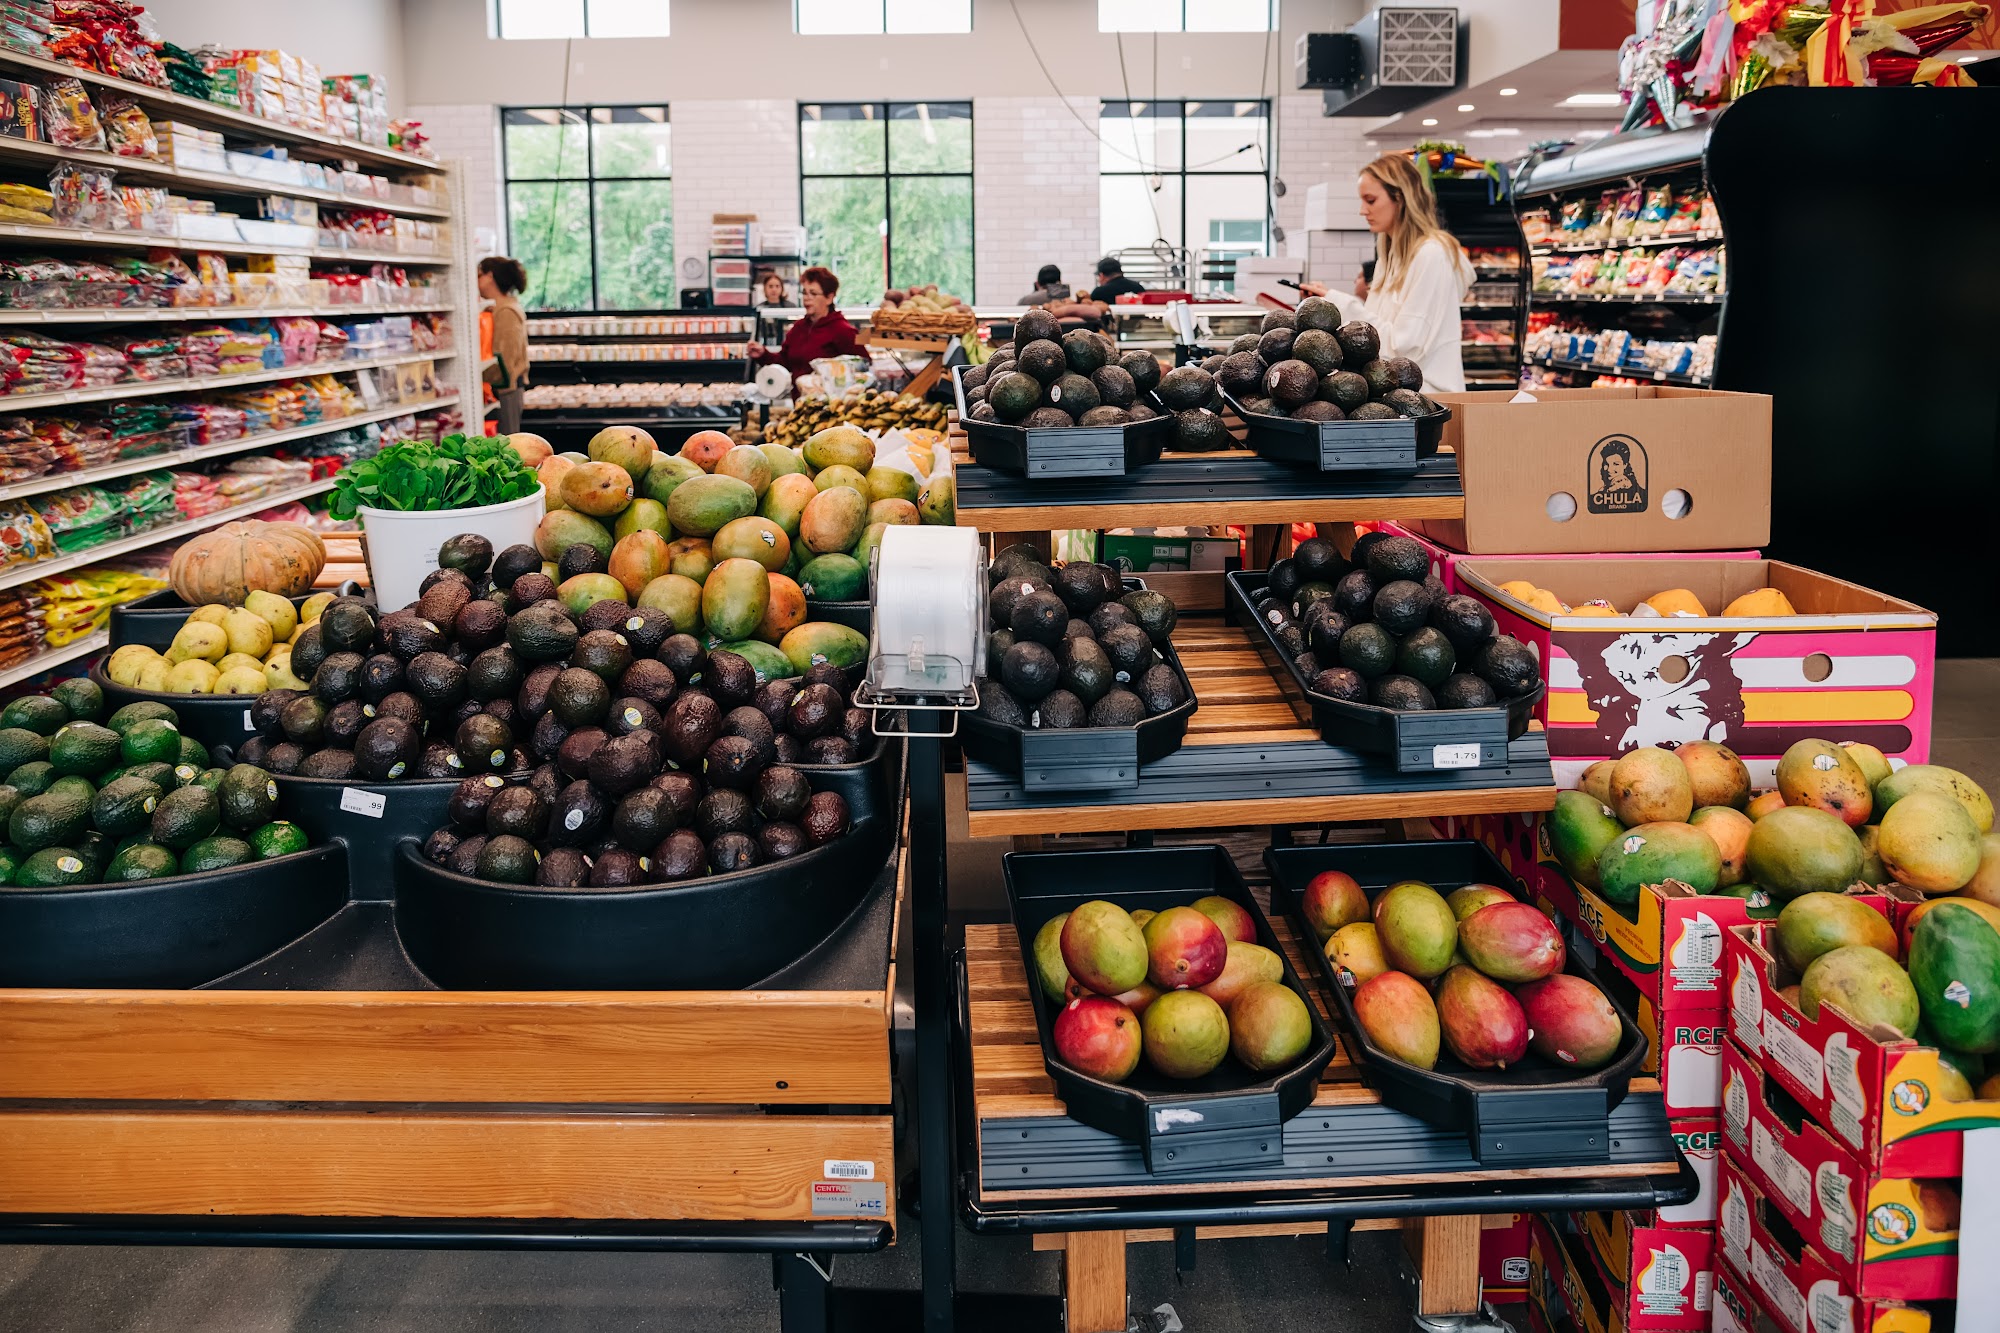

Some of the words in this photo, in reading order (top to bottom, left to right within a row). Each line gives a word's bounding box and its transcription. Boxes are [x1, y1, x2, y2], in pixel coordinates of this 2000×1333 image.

[1593, 492, 1642, 504] CHULA
[1578, 892, 1604, 928] RCF
[1675, 1027, 1727, 1044] RCF
[1718, 1274, 1746, 1322] RCF
